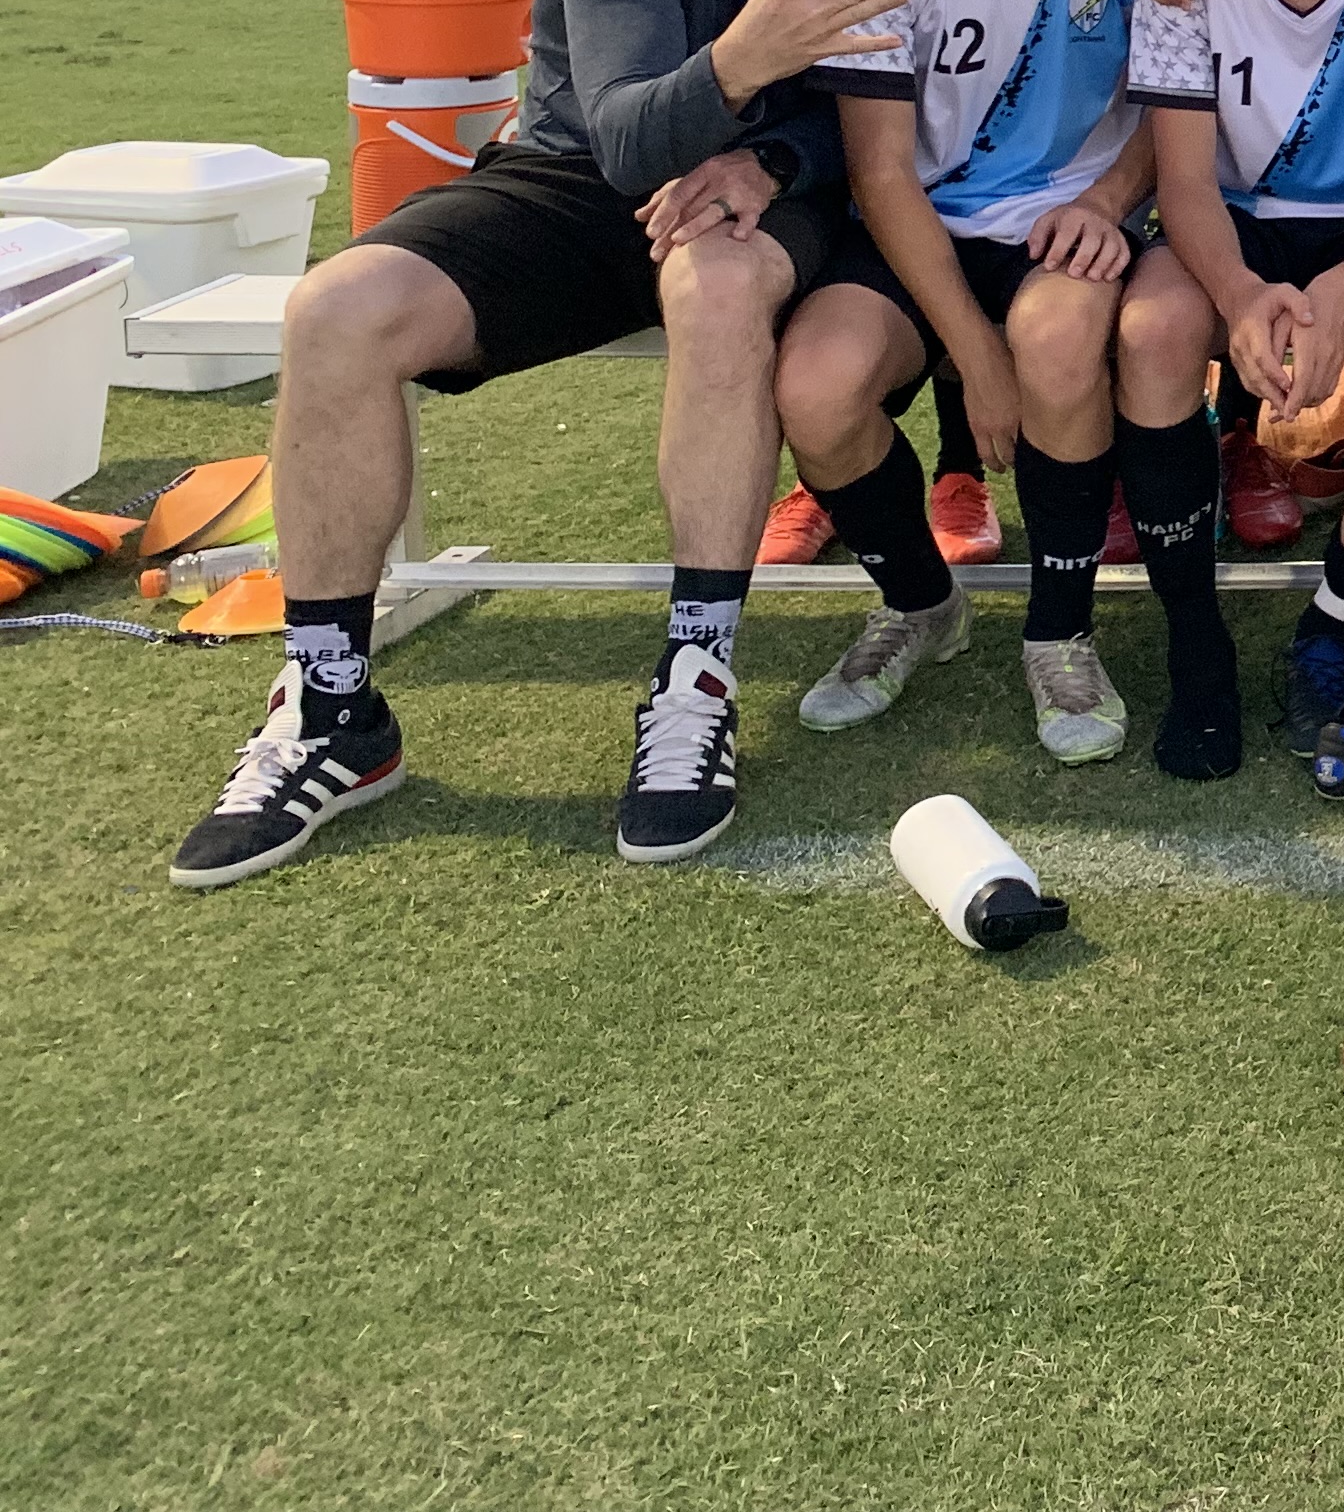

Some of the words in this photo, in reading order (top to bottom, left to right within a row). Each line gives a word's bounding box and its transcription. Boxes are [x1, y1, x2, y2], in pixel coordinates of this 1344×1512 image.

[1085, 12, 1100, 22] FC
[1138, 502, 1212, 536] HAILEY
[1163, 527, 1194, 547] FC
